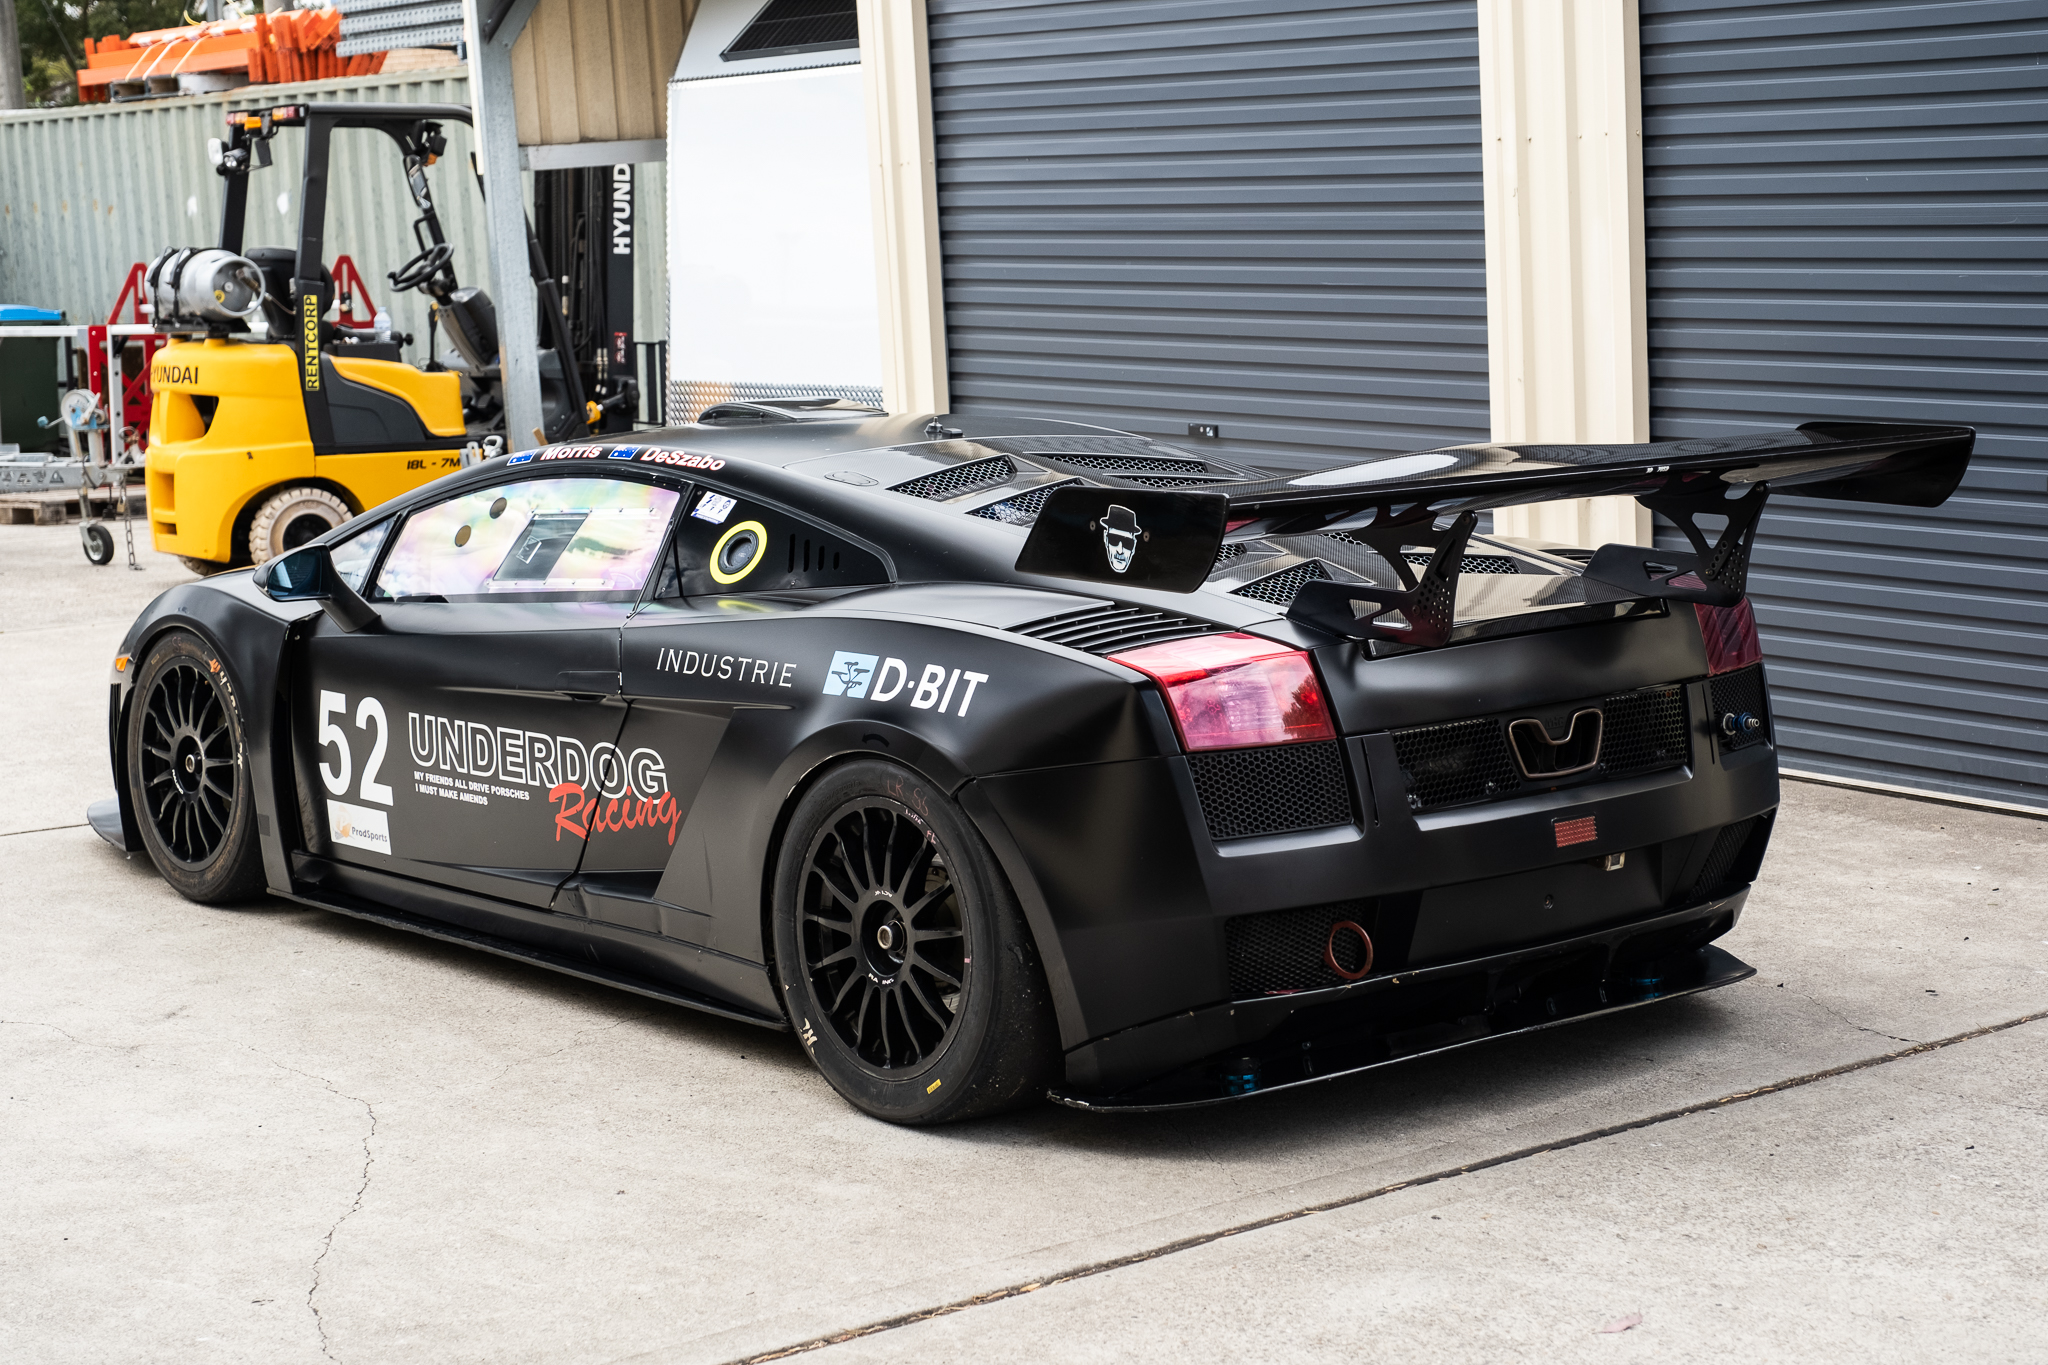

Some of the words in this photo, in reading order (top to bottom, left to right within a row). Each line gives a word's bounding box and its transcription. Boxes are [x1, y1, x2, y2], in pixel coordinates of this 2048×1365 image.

[305, 296, 318, 389] RENTCORP
[540, 445, 603, 461] Morris
[640, 447, 726, 471] DeSzabo
[656, 647, 797, 688] INDUSTRIE
[318, 689, 394, 806] 52
[408, 712, 670, 804] UNDERDOG
[414, 771, 424, 781] MY
[425, 773, 454, 787] FRIENDS
[454, 778, 468, 790] ALL
[468, 781, 490, 794] DRIVE
[491, 785, 530, 801] PORSCHES
[415, 783, 418, 792] I
[419, 783, 438, 796] MUST
[438, 787, 458, 800] MAKE
[459, 792, 488, 806] AMENDS
[351, 826, 388, 843] ProdSports
[548, 783, 683, 846] Racing
